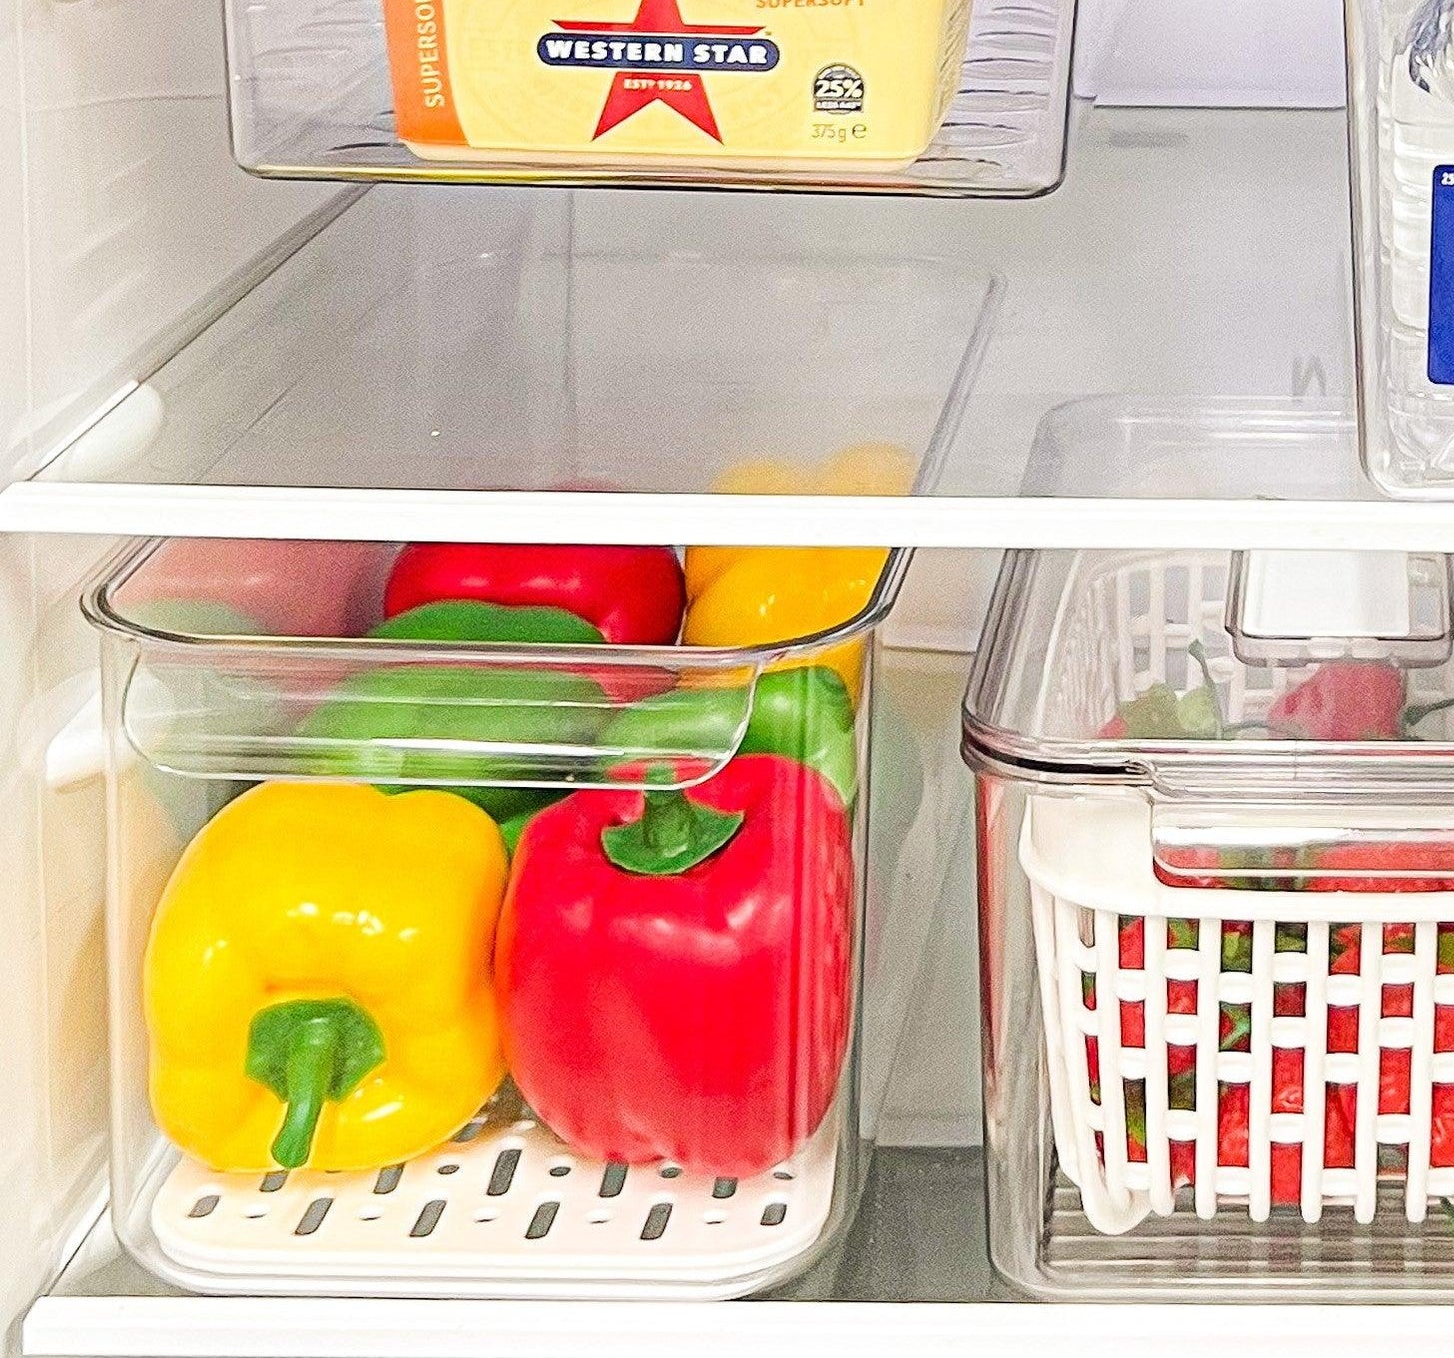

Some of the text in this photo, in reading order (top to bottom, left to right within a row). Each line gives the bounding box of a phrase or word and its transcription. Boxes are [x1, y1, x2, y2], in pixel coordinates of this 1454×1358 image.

[546, 40, 769, 64] WESTERN STAR
[815, 79, 863, 98] 25%
